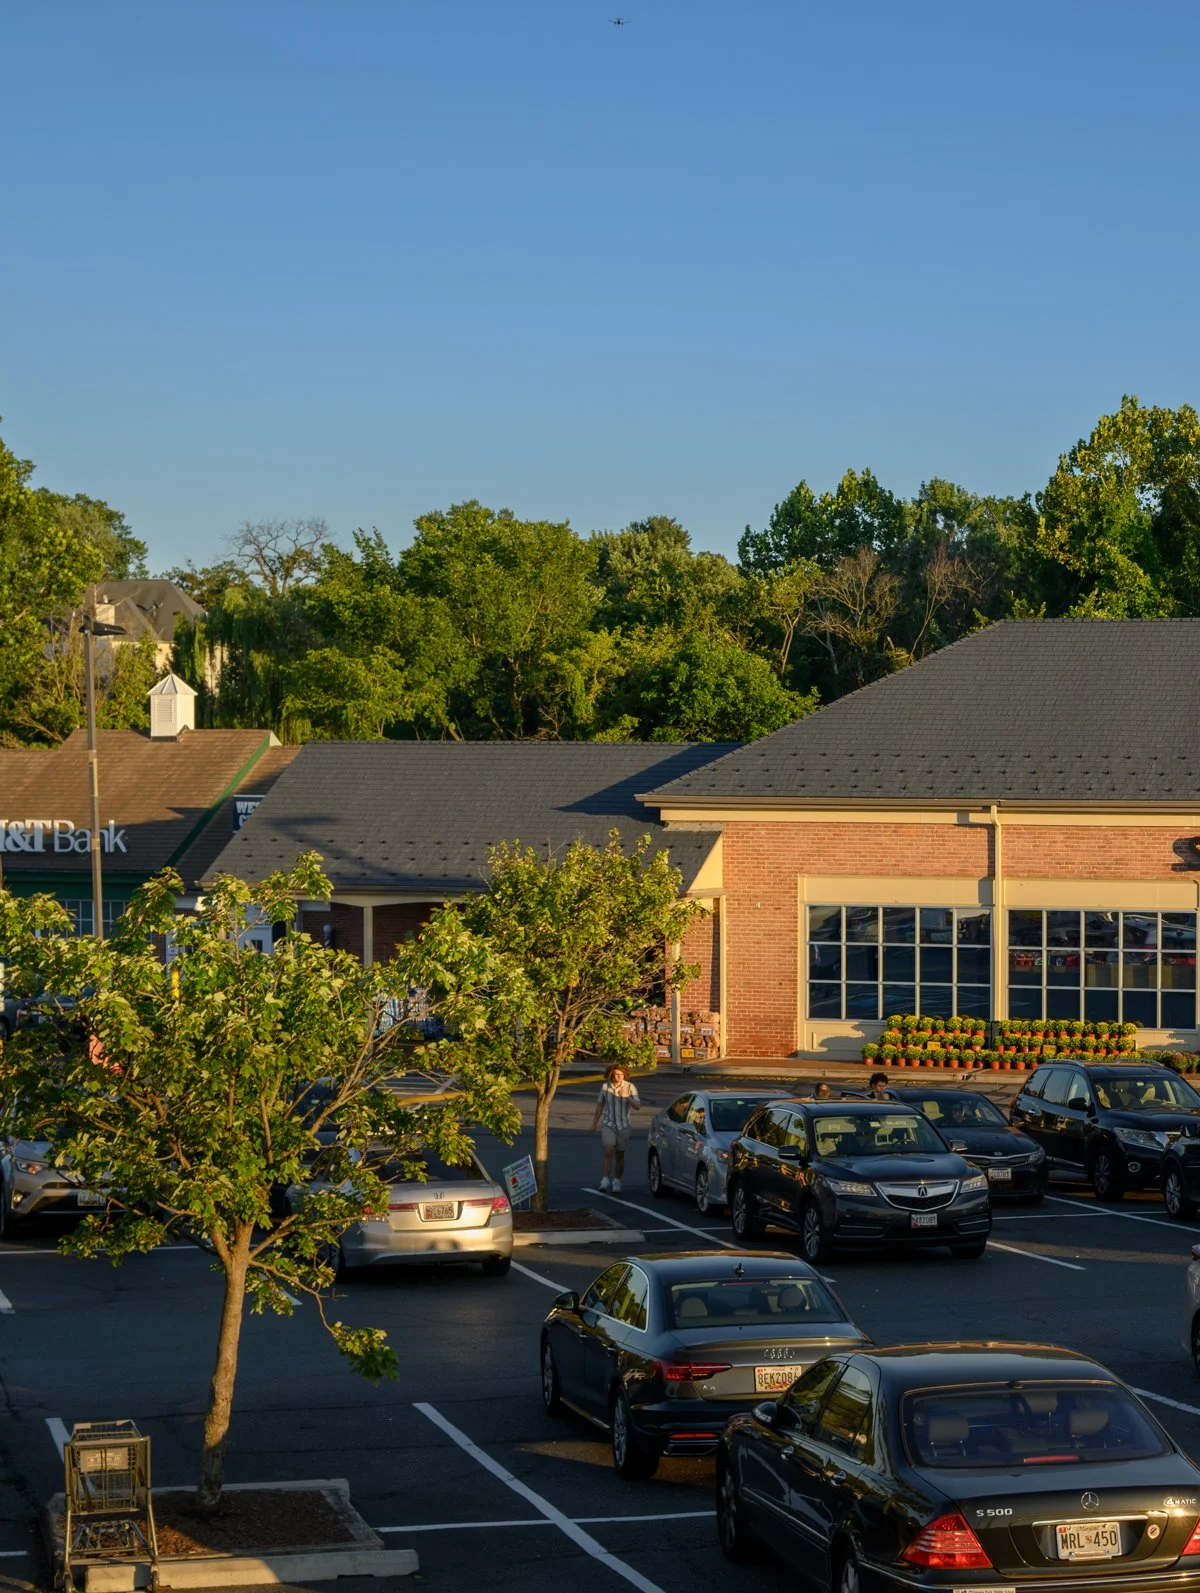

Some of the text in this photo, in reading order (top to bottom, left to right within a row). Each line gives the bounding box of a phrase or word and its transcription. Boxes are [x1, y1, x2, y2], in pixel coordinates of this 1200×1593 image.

[54, 819, 127, 853] Bank
[976, 1508, 1013, 1517] S 500
[1060, 1530, 1117, 1550] MRL 450
